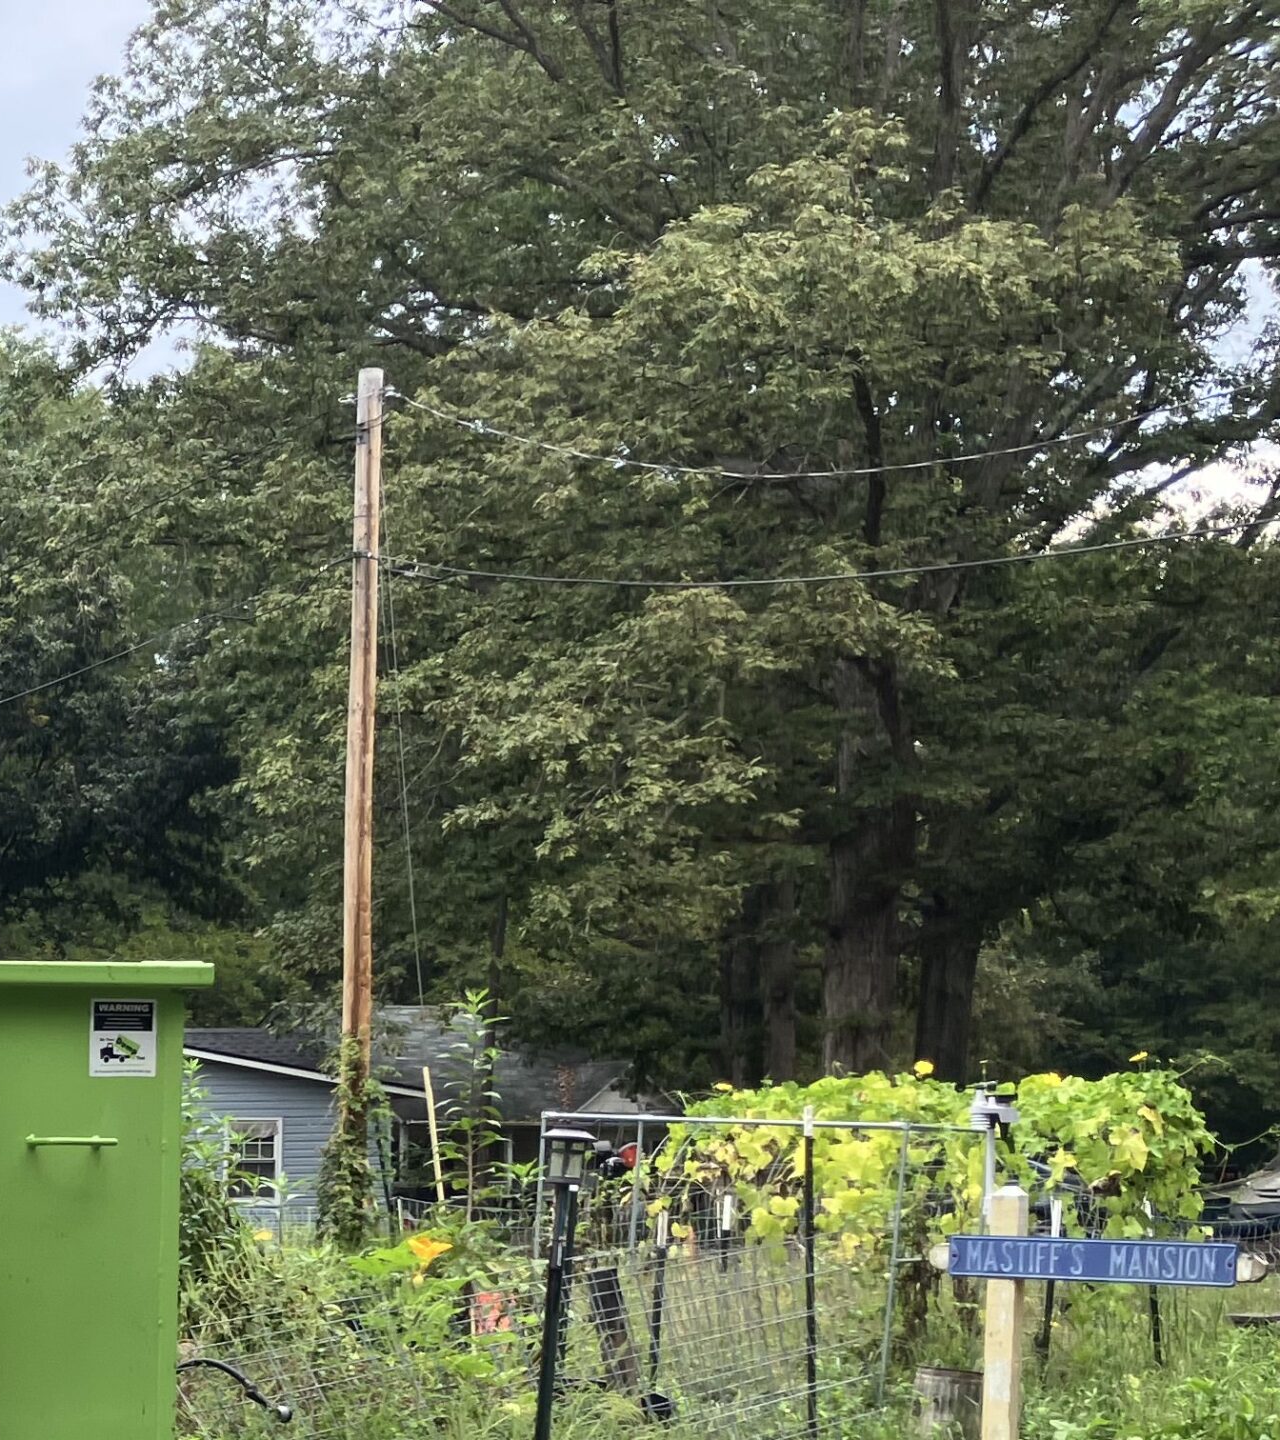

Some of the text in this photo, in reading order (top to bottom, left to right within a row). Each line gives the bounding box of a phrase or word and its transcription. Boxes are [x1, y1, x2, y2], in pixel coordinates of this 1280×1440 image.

[99, 1003, 150, 1013] WARNING
[965, 1240, 1219, 1281] MASTIFF'S MANSION
